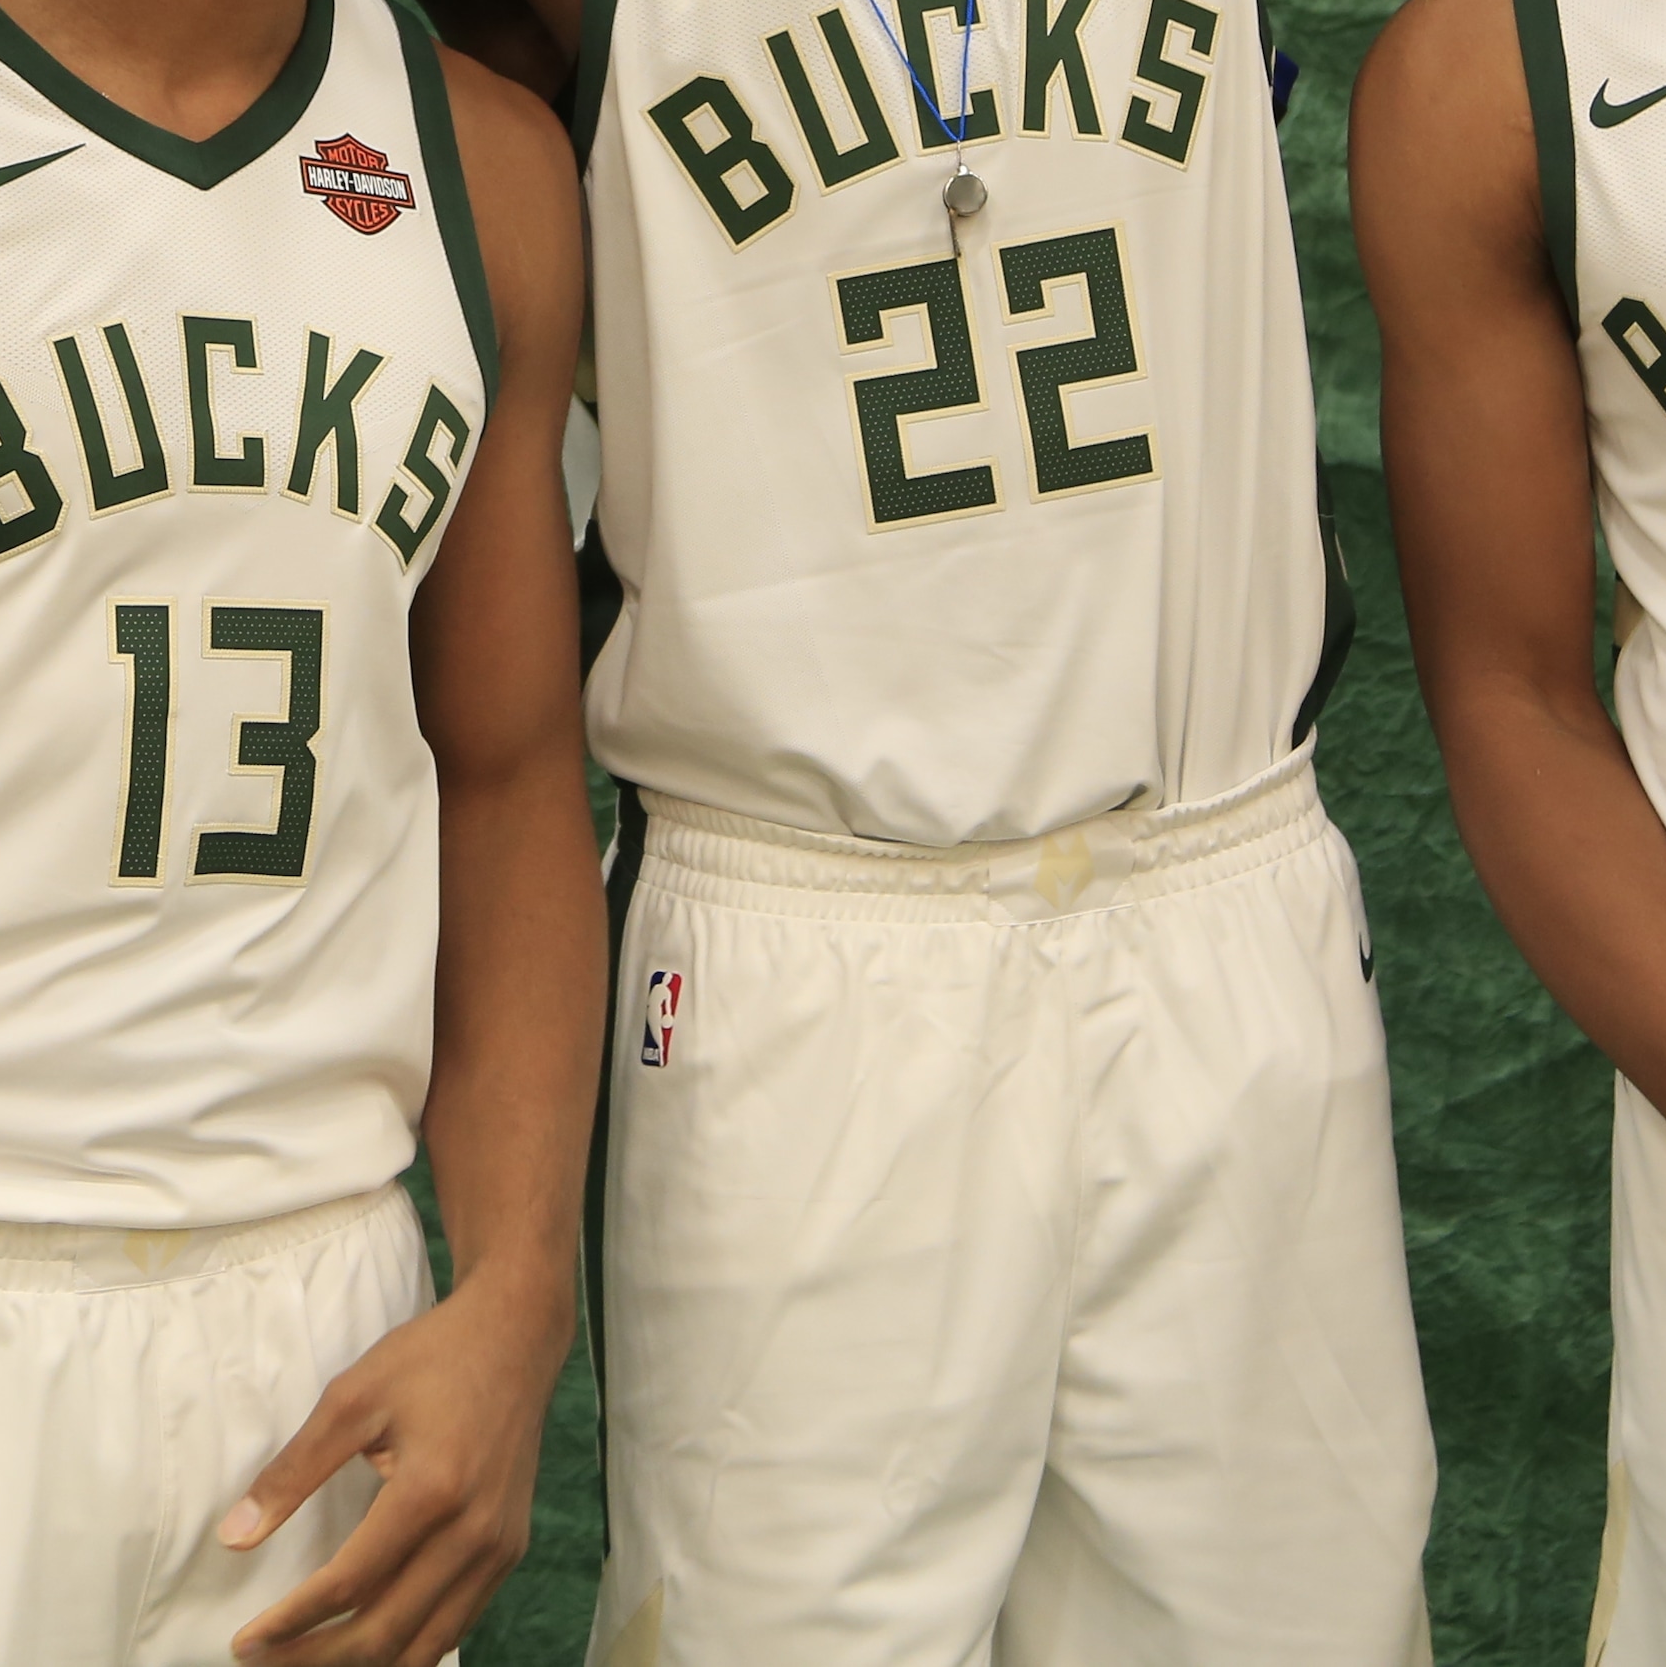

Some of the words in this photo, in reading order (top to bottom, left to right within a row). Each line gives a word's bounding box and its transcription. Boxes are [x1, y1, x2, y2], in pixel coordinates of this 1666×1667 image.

[327, 145, 379, 170] MOTOR
[308, 166, 408, 200] HARLEY-DAVIDSON
[336, 198, 388, 225] CYCLES
[827, 221, 1162, 535] 22
[106, 595, 330, 888] 13
